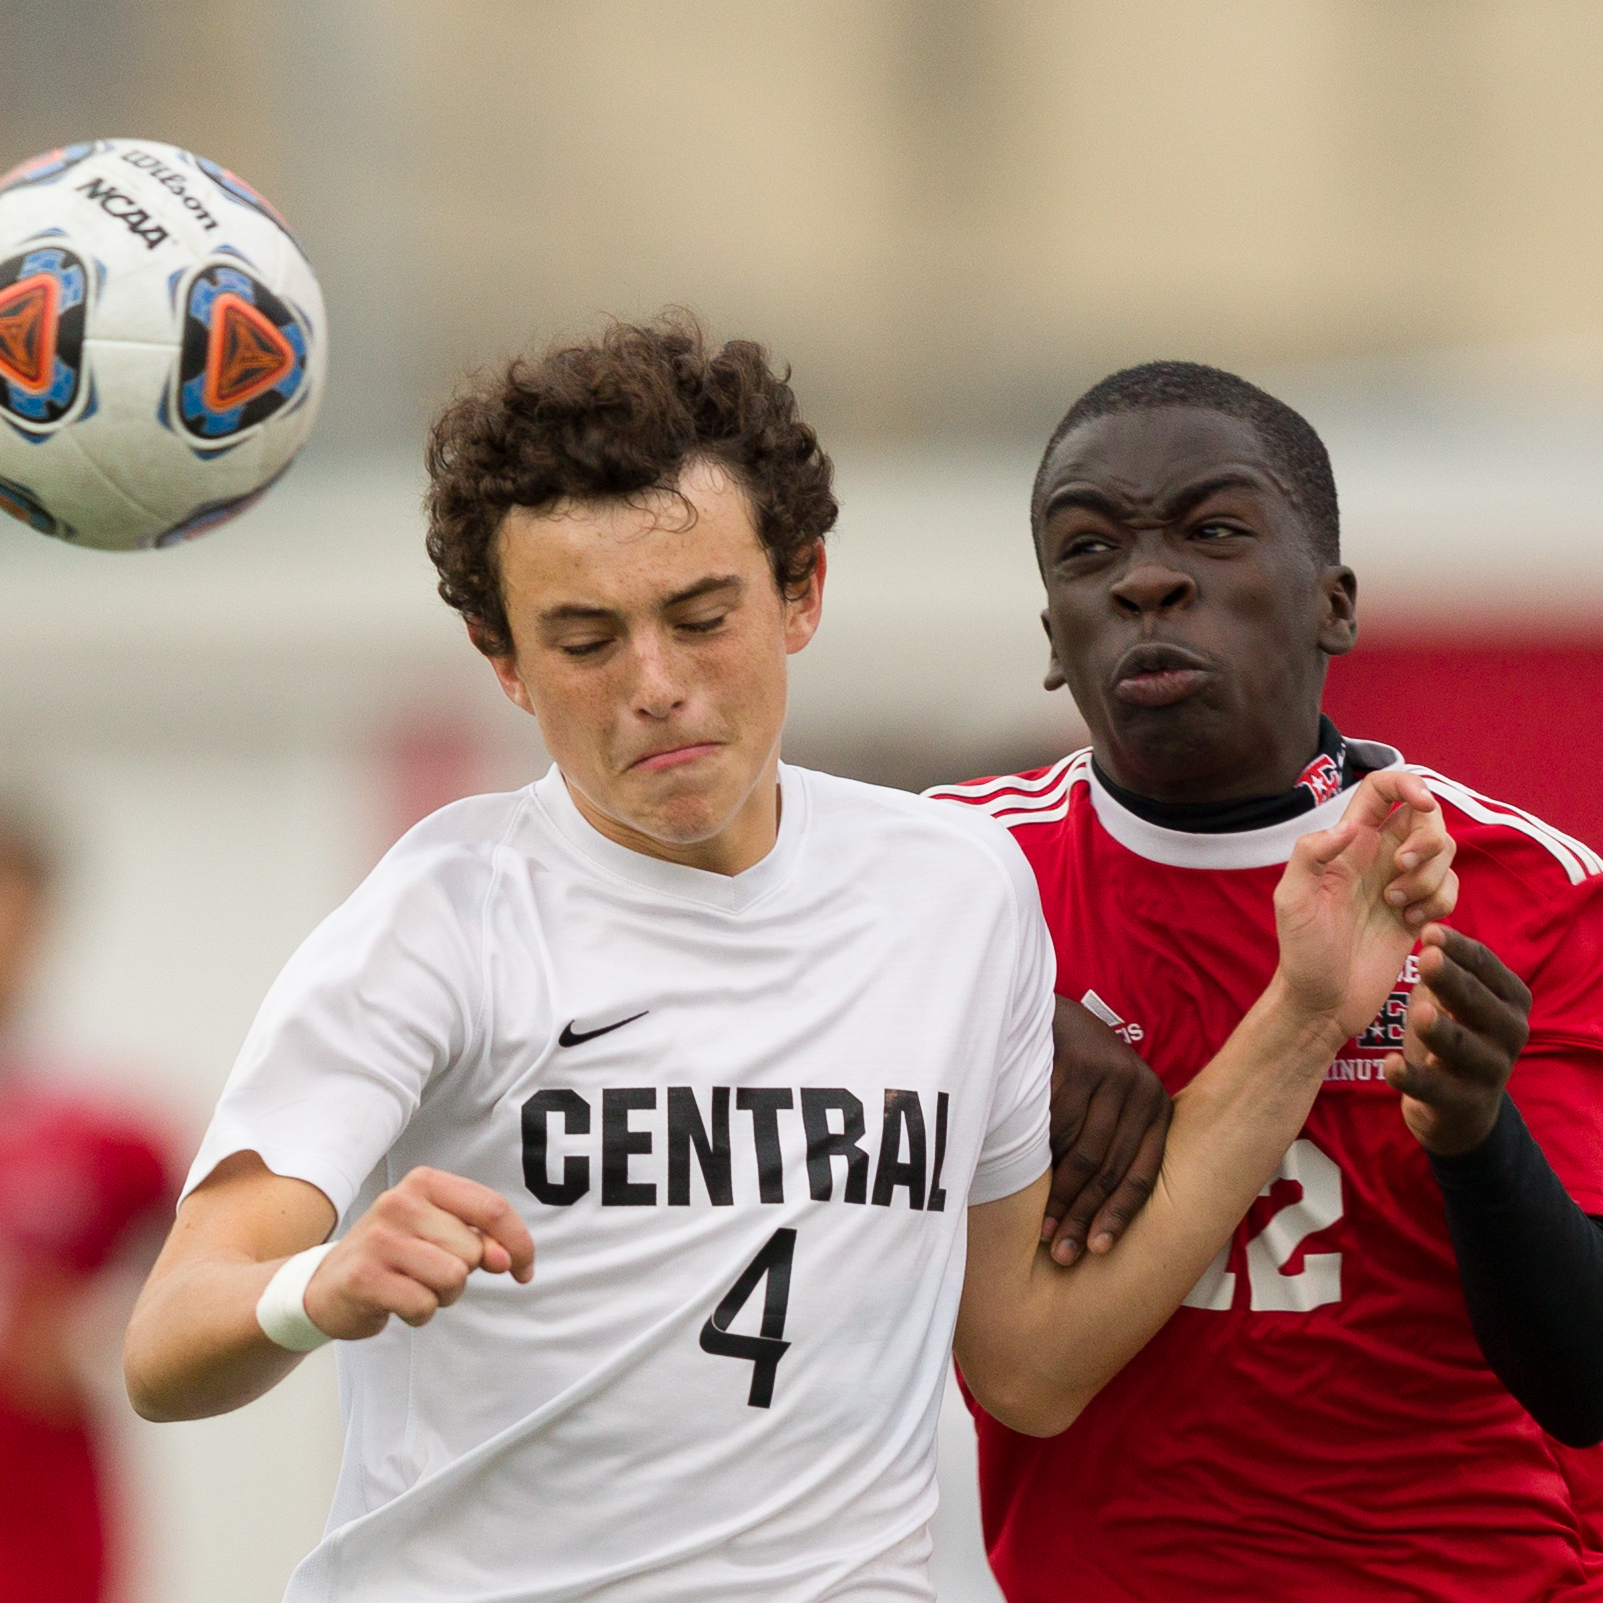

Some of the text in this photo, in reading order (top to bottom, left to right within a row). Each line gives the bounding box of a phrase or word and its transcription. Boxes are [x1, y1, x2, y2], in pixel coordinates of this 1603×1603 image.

[75, 177, 168, 250] NCAA
[121, 150, 218, 231] Wilson
[521, 1086, 950, 1212] CENTRAL
[699, 1227, 798, 1409] 4
